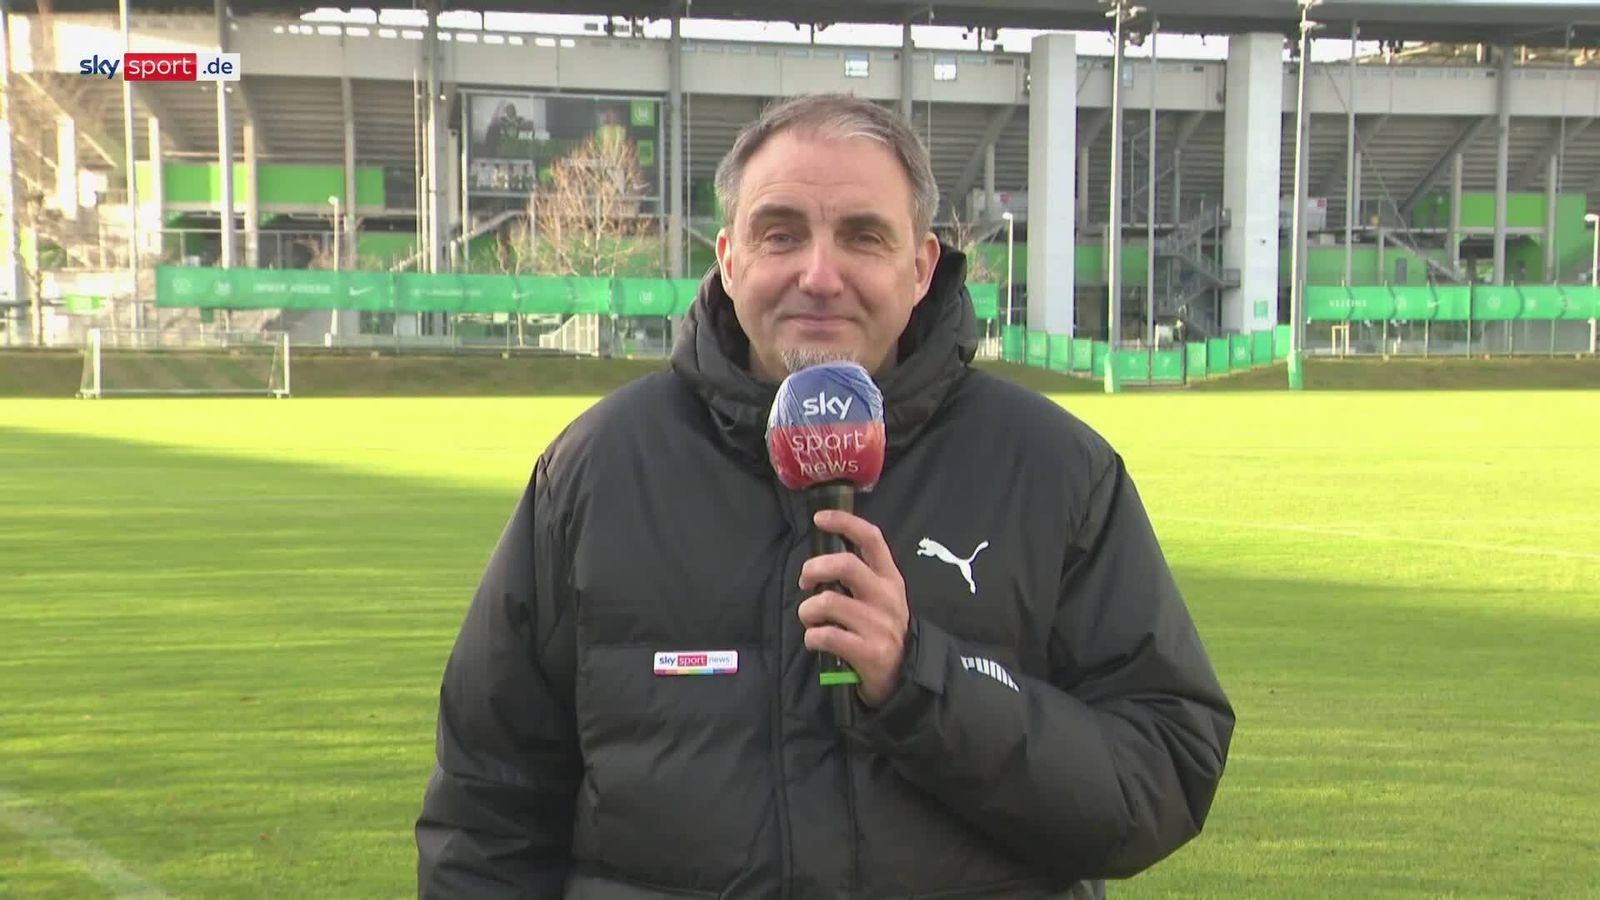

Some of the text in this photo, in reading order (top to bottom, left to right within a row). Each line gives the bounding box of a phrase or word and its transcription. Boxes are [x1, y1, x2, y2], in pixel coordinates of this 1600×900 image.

[803, 391, 853, 420] sky
[793, 429, 867, 455] sport
[801, 459, 859, 476] news
[659, 655, 730, 666] sky sport news
[960, 655, 1020, 693] PUMA
